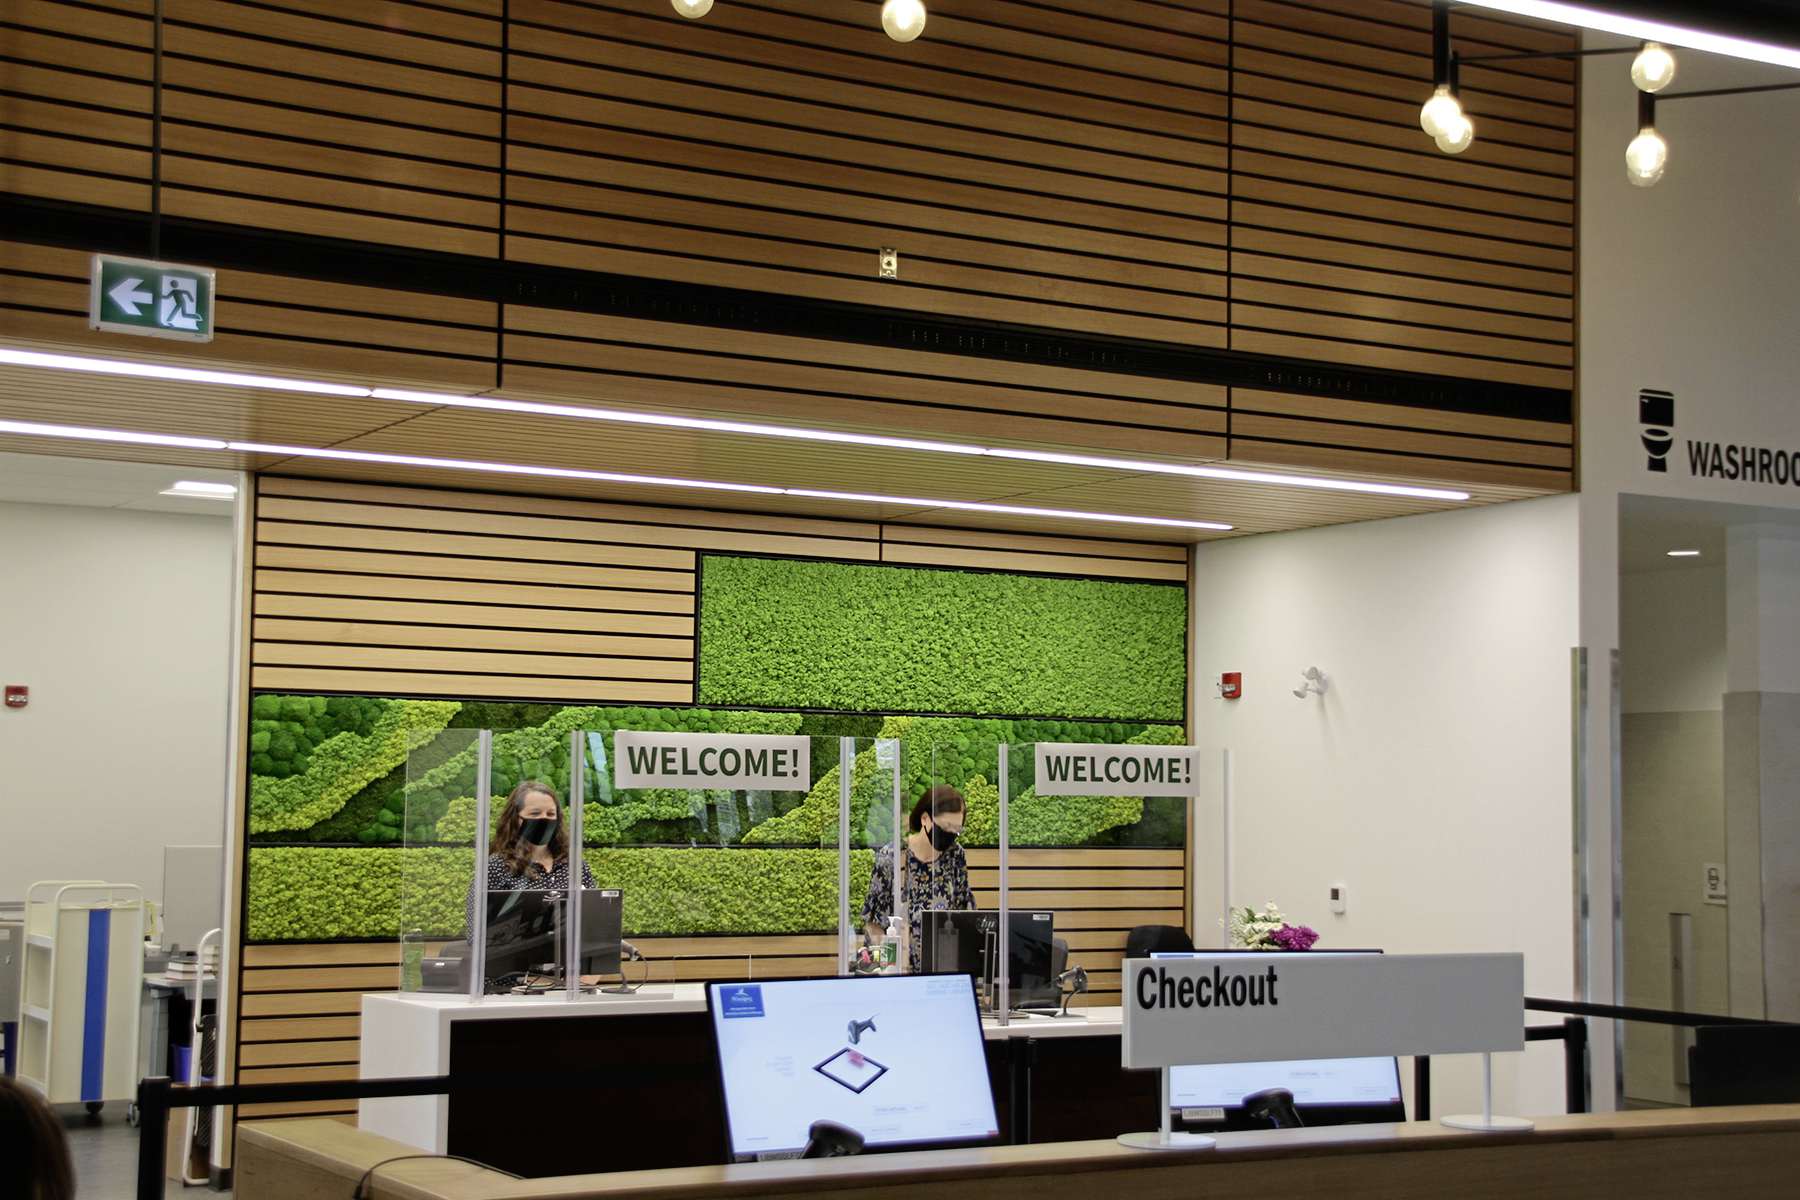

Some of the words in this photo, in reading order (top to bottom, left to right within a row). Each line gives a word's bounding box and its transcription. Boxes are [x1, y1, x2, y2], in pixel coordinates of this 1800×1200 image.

[627, 746, 800, 779] WELCOME!
[1044, 755, 1191, 784] WELCOME!
[1136, 965, 1279, 1010] Checkout
